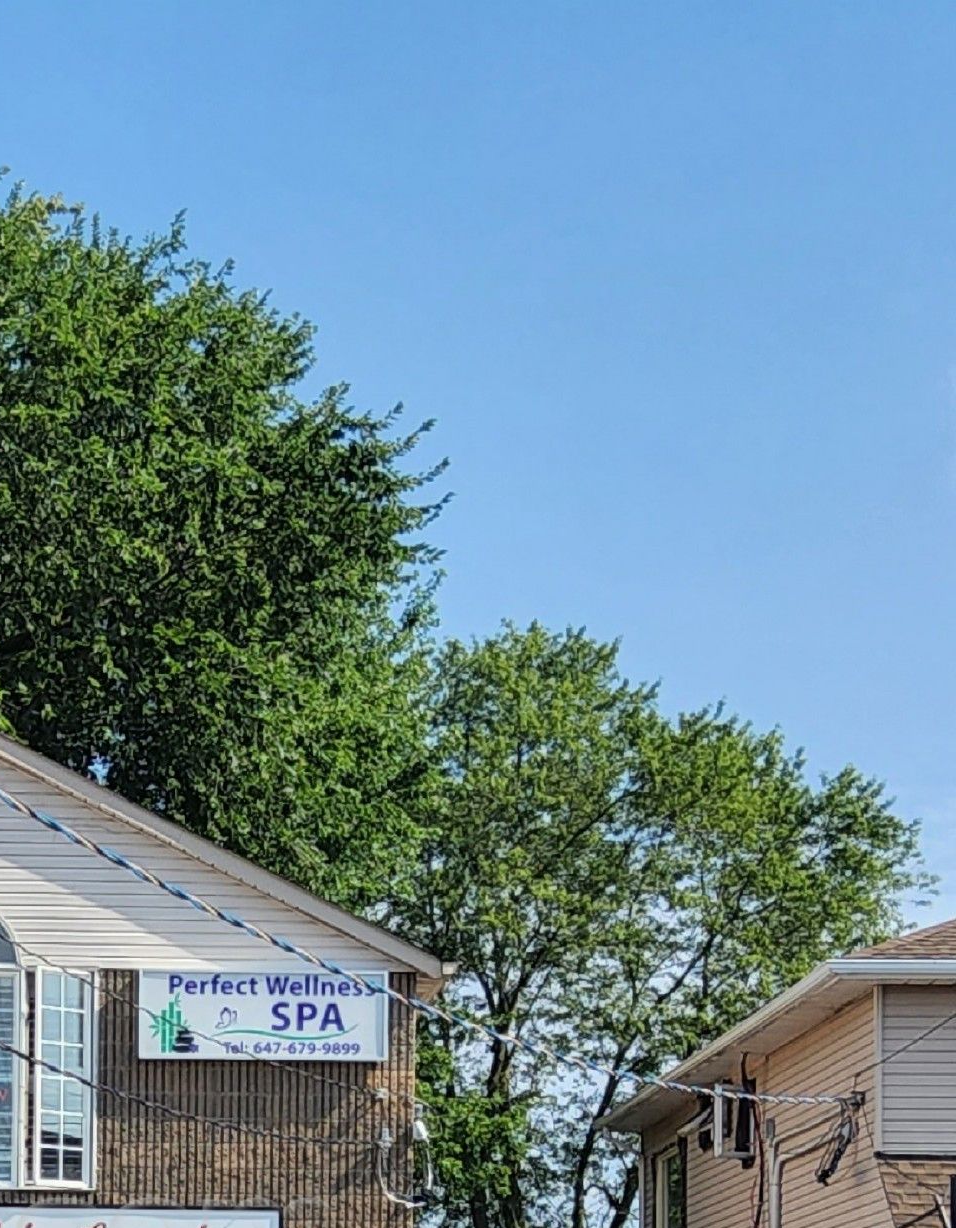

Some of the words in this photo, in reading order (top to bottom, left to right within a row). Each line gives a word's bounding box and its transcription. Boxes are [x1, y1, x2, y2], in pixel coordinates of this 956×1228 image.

[169, 974, 258, 996] Perfect
[271, 1002, 345, 1032] SPA
[224, 1041, 248, 1054] Tel:
[253, 1041, 361, 1055] 647-679-9899
